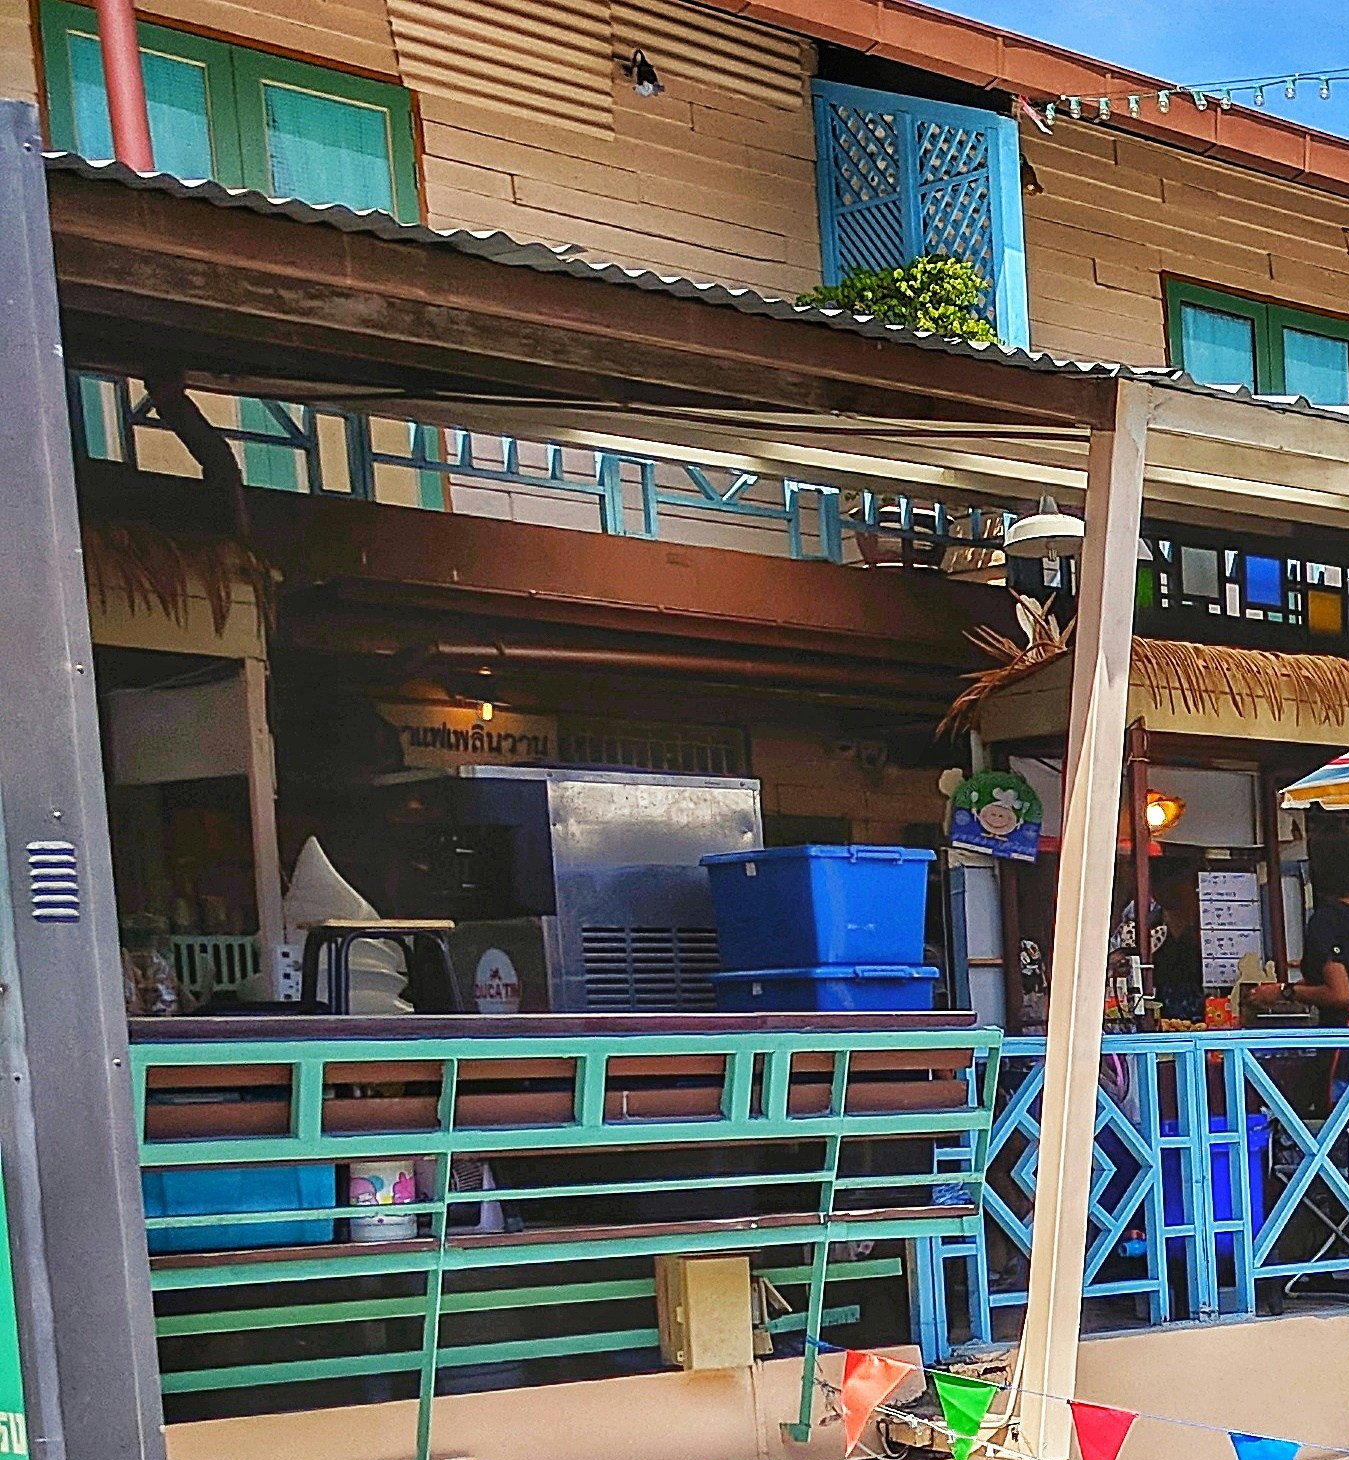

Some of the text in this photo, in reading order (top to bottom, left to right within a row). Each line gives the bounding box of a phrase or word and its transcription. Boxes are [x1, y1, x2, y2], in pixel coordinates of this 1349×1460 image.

[401, 720, 549, 755] าแฟเพลินวาน
